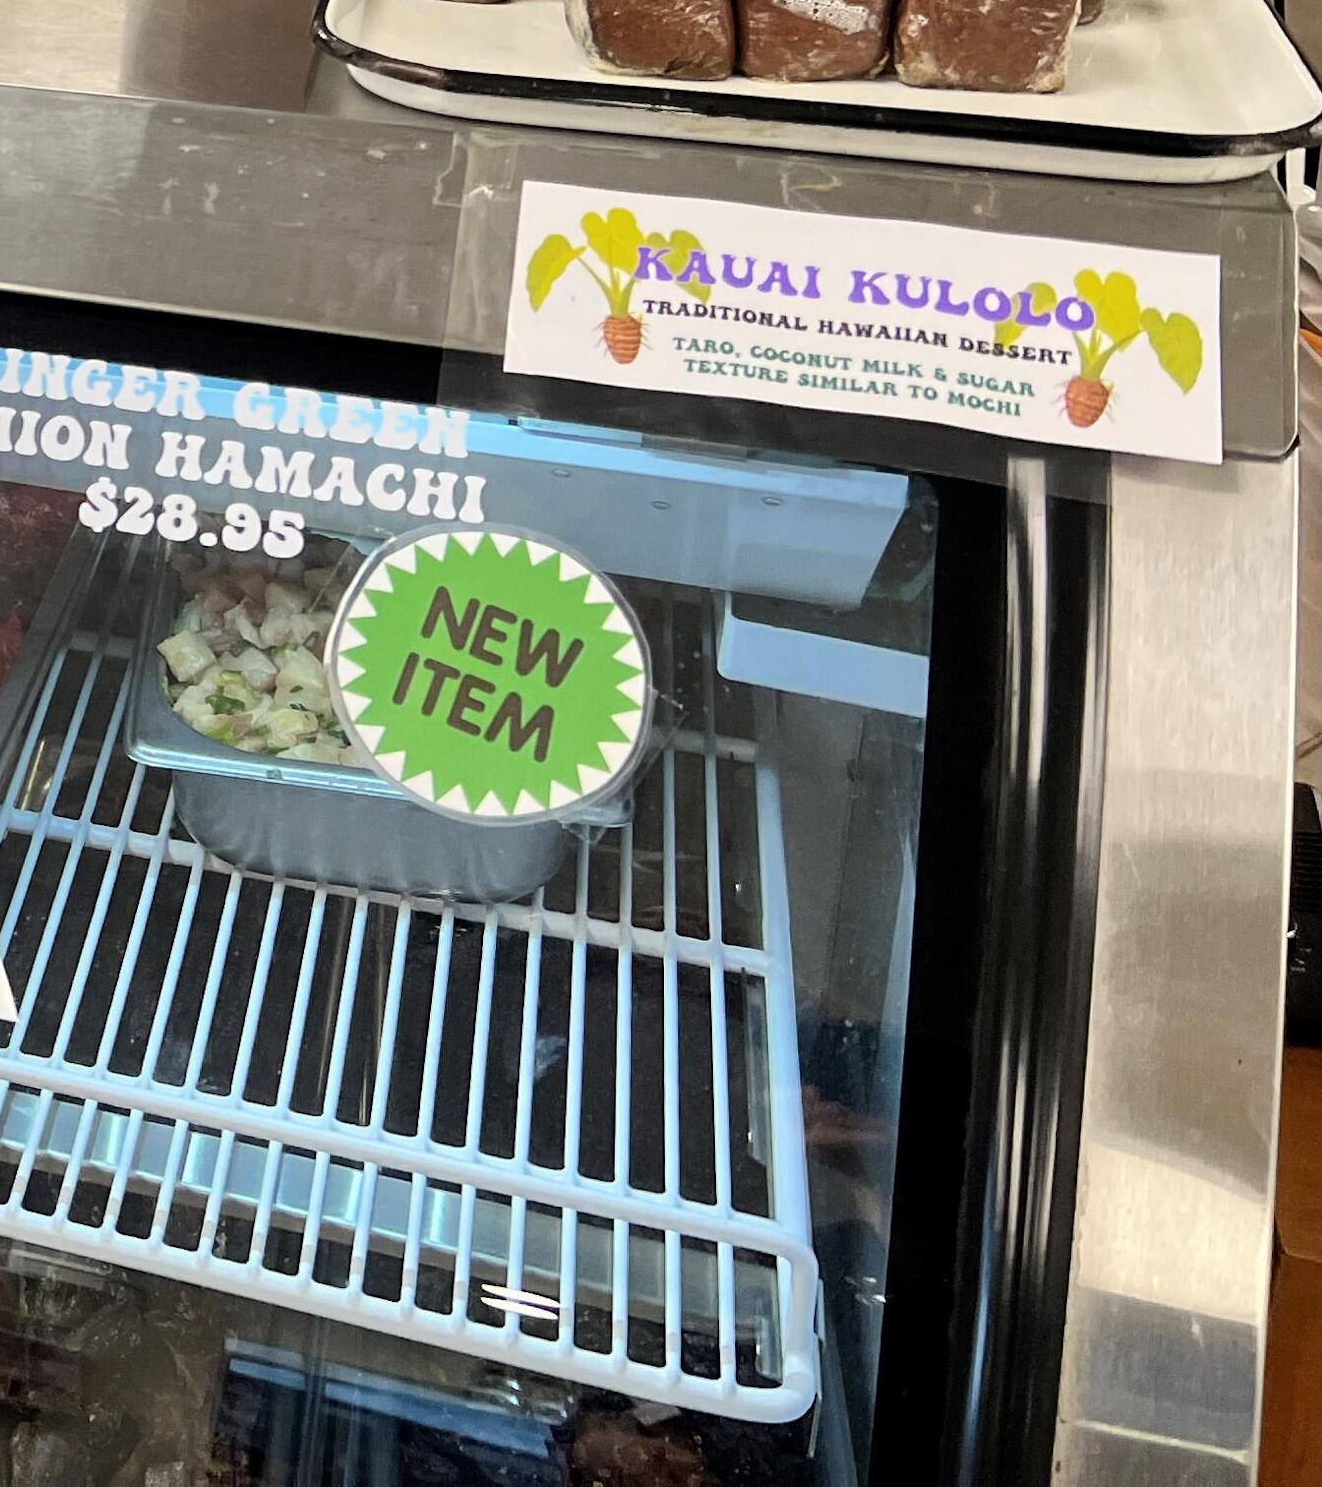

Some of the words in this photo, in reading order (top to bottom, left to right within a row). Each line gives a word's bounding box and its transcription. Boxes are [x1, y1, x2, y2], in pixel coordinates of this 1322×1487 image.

[634, 245, 822, 301] KAUAI
[848, 270, 1096, 331] KULOLO
[643, 299, 808, 332] TRADITIONAL
[817, 317, 950, 349] HAWAIIAN
[958, 337, 1073, 367] DESSERT
[672, 335, 742, 359] TARO,
[750, 342, 852, 372] COCONUT
[862, 357, 924, 379] MILK
[934, 365, 949, 382] &
[956, 369, 1036, 399] SUGAR
[233, 381, 470, 459] GREEN
[683, 357, 789, 385] TEXTURE
[797, 371, 899, 397] SIMILAR
[908, 382, 940, 402] TO
[948, 389, 1022, 417] MOCHI
[78, 475, 308, 560] $28.95
[155, 431, 487, 524] HAMACHI
[420, 583, 586, 691] NEW
[392, 650, 558, 765] ITEM
